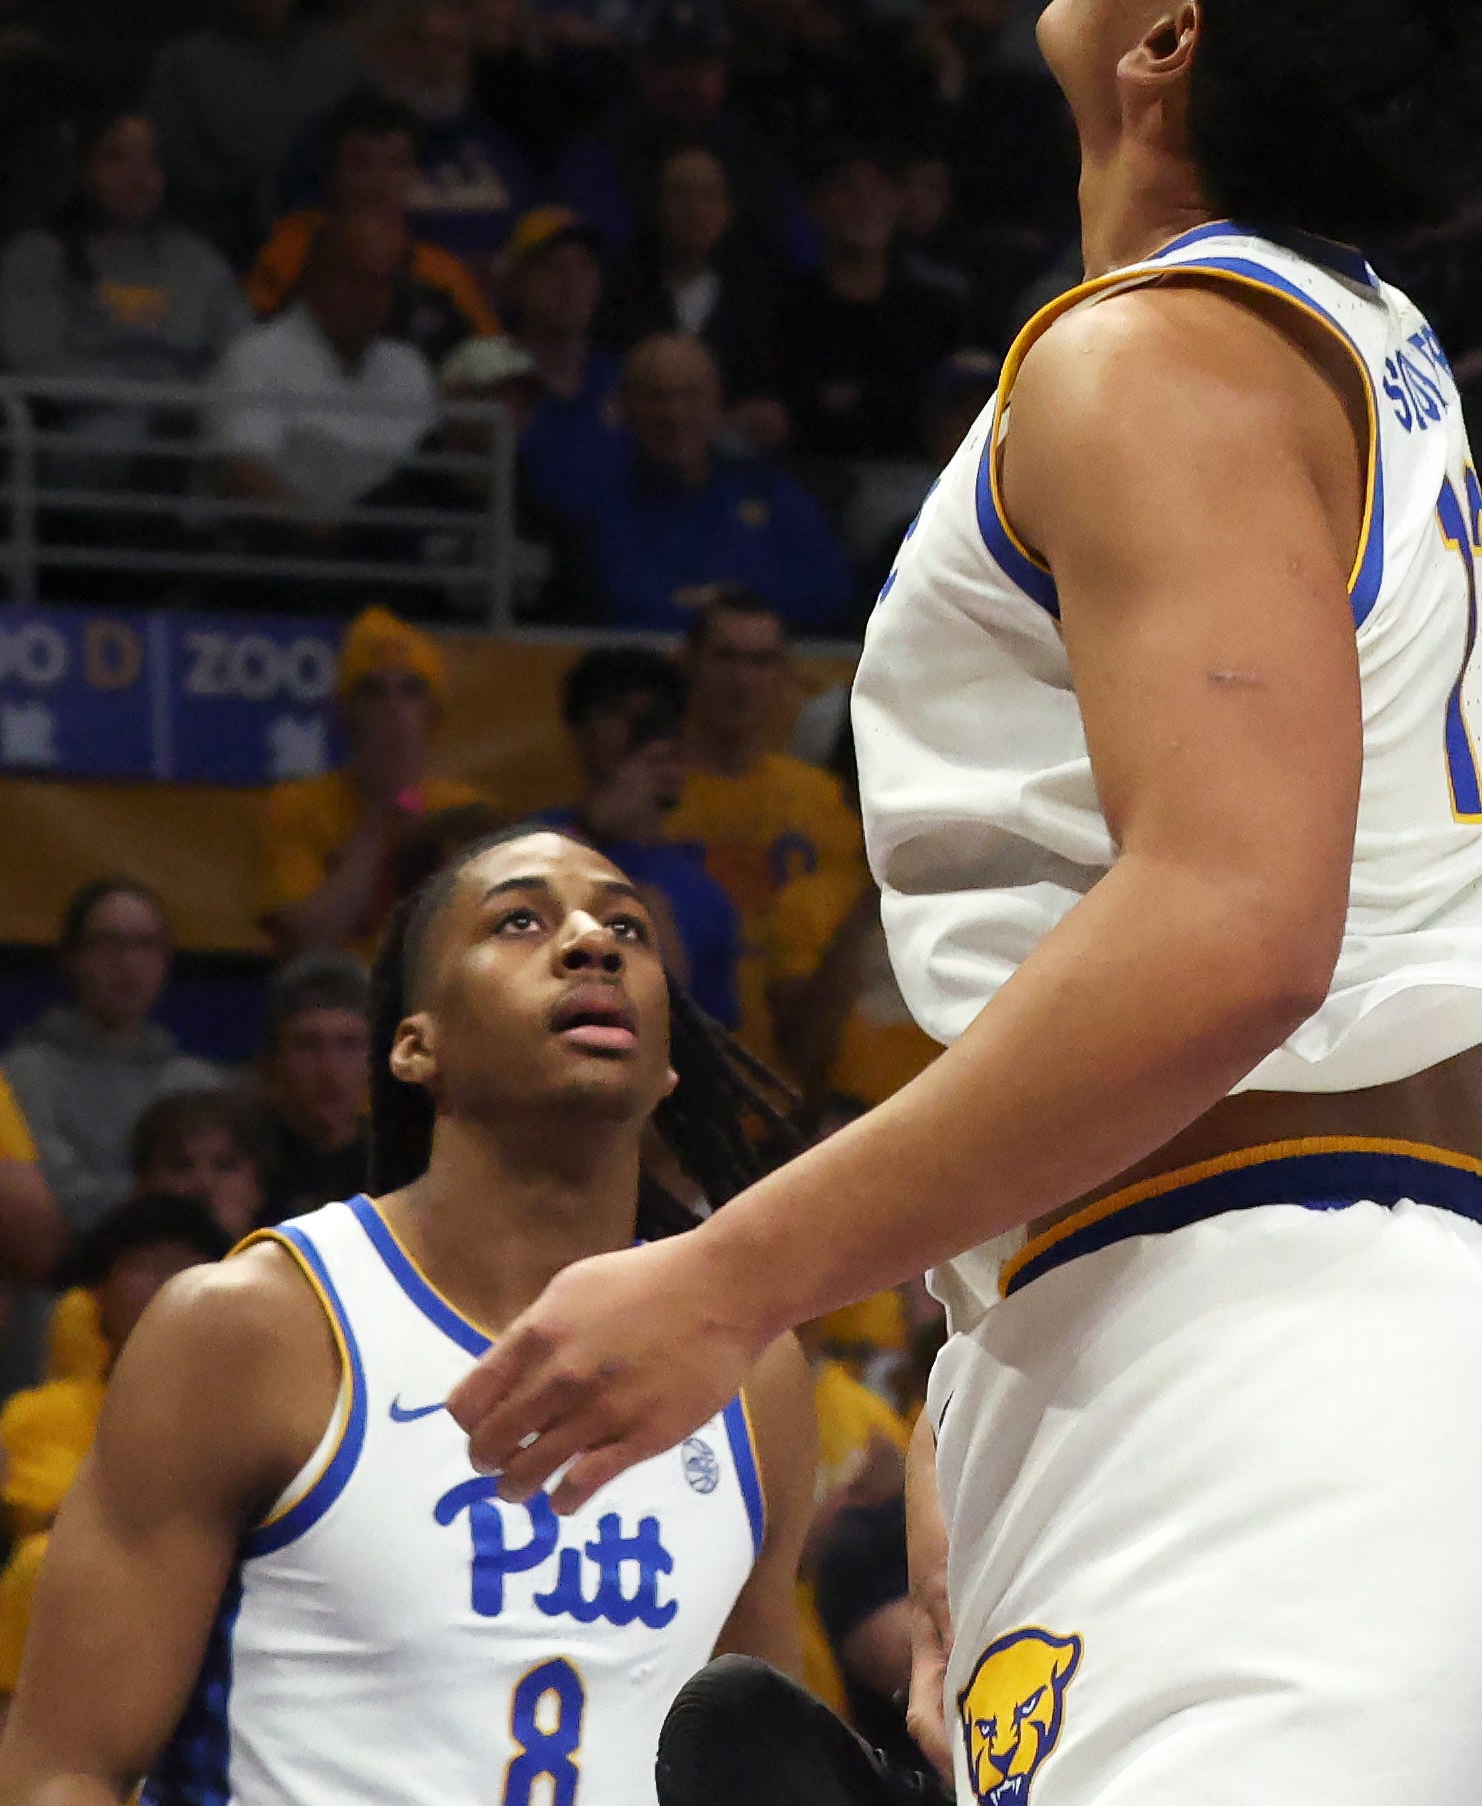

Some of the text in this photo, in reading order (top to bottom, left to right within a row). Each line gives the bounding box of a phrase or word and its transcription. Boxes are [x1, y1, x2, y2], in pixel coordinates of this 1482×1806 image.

[186, 630, 338, 701] ZOO
[433, 1476, 678, 1630] Pitt
[502, 1654, 587, 1806] 8
